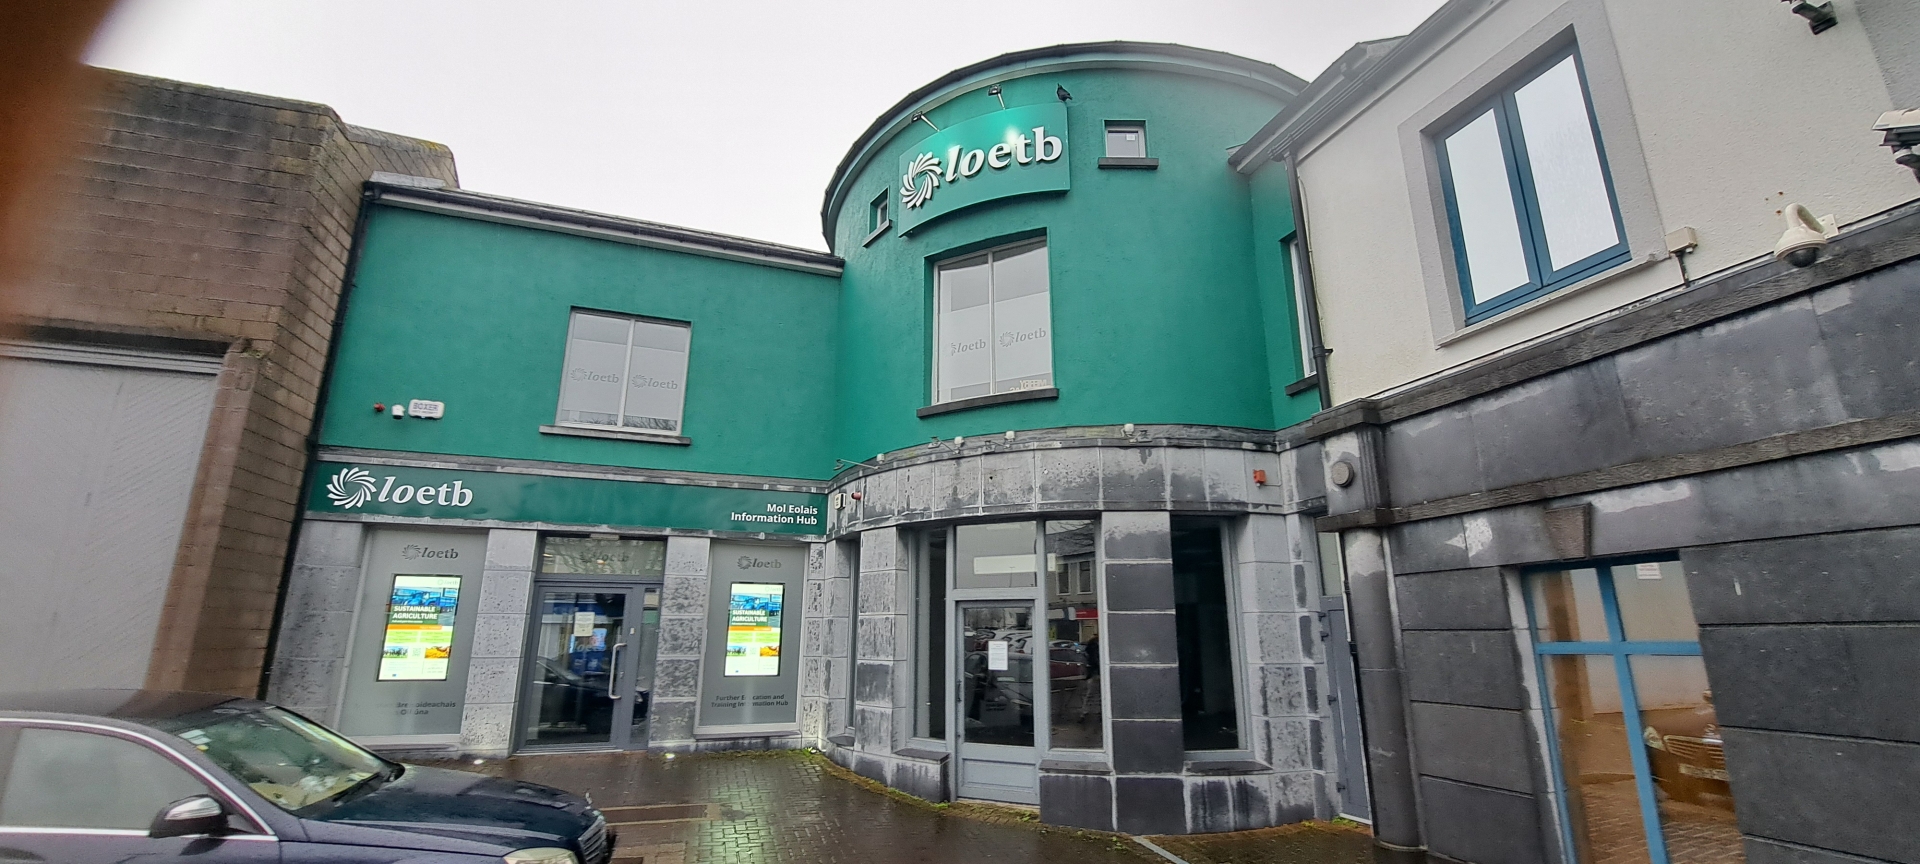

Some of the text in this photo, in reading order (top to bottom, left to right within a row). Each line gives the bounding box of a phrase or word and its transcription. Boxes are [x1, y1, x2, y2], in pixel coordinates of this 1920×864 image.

[945, 125, 1063, 182] loetb
[1015, 327, 1047, 343] loetb
[956, 338, 987, 353] loetb
[587, 370, 620, 384] loetb
[647, 377, 678, 390] loetb
[377, 476, 474, 507] loetb
[766, 503, 818, 515] Mol Eolais
[731, 511, 818, 525] Information Hub
[421, 547, 459, 559] loetb
[752, 558, 782, 569] loetb
[392, 612, 438, 620] AGRICULTURE
